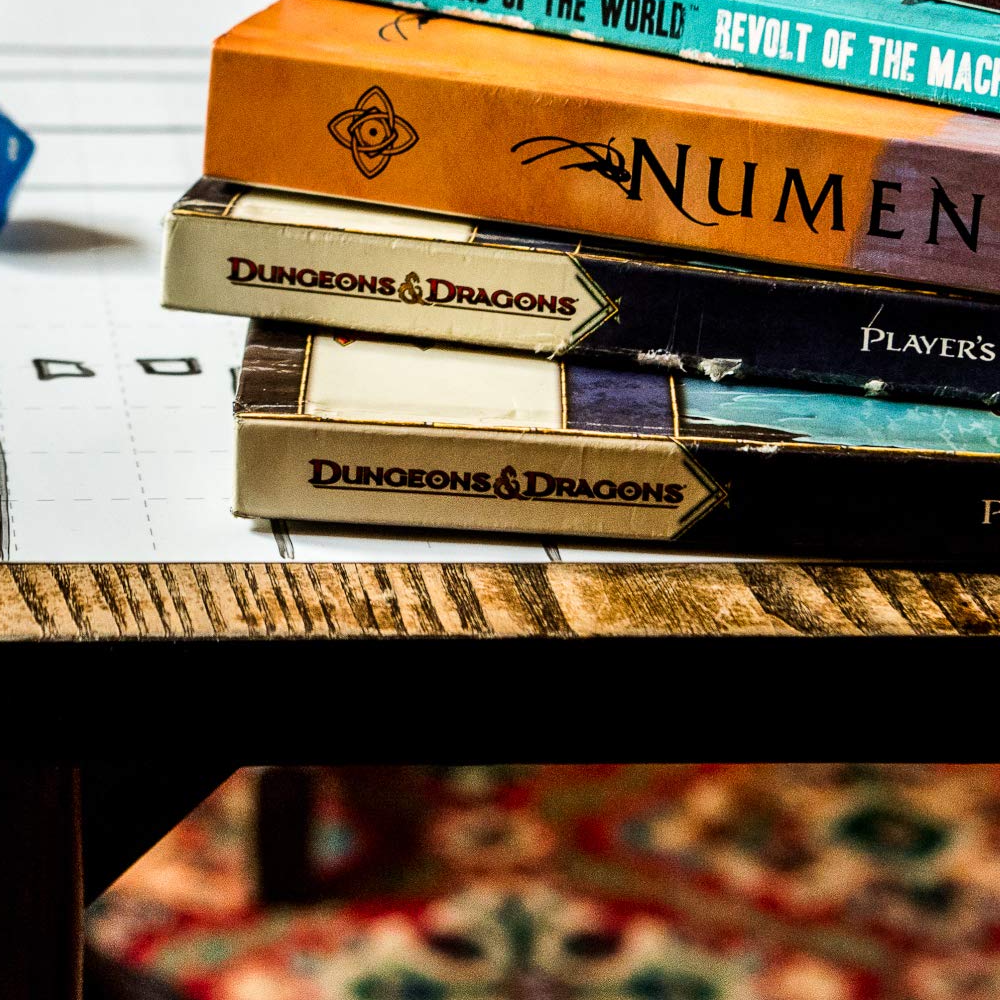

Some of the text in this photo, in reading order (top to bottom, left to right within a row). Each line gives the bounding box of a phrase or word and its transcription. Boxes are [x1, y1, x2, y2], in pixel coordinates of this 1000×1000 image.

[714, 9, 812, 63] REVOLT
[822, 28, 856, 70] OF
[869, 35, 918, 83] THE
[627, 137, 985, 252] NUMEN
[860, 326, 997, 362] PLAYER'S
